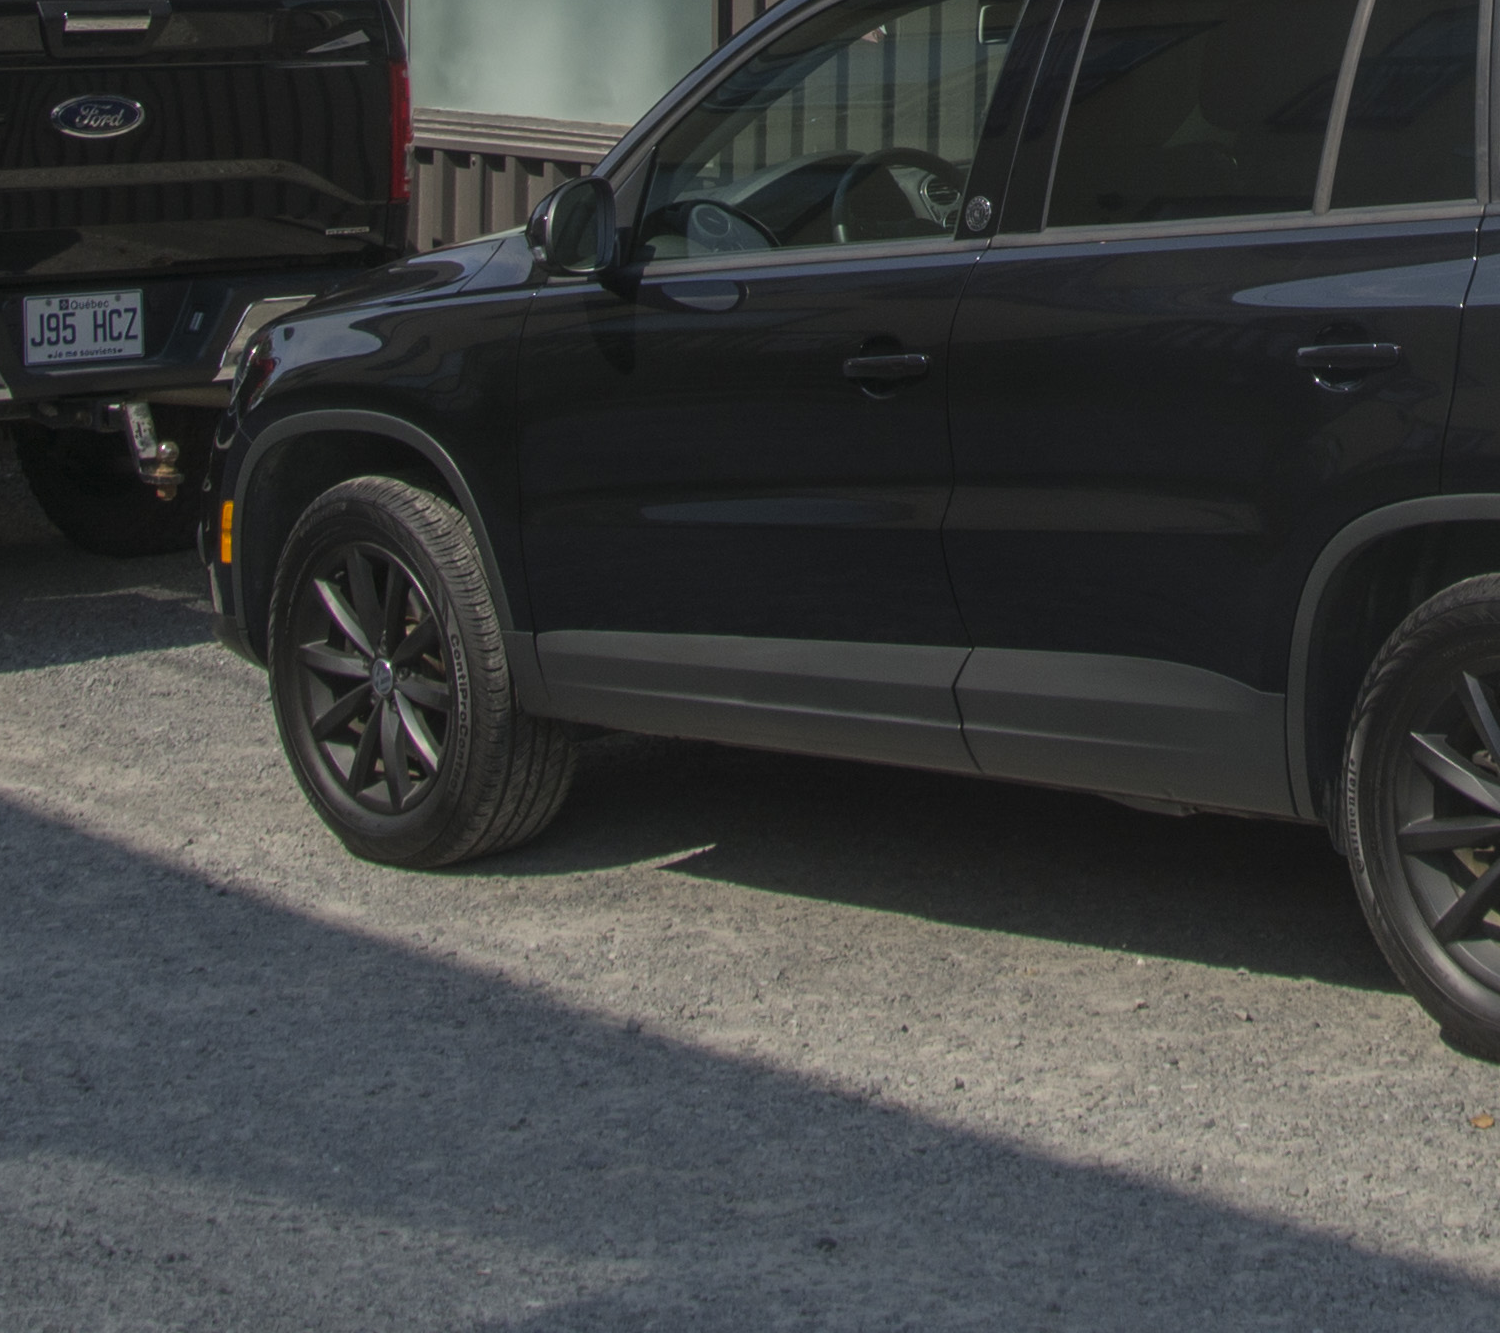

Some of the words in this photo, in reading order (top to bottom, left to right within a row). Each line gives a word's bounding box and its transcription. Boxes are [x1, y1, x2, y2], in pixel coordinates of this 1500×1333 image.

[75, 104, 125, 128] Ford
[70, 299, 110, 310] Québec
[31, 312, 77, 347] J95
[93, 307, 138, 343] HCZ
[65, 349, 78, 357] me
[80, 347, 117, 357] souviens
